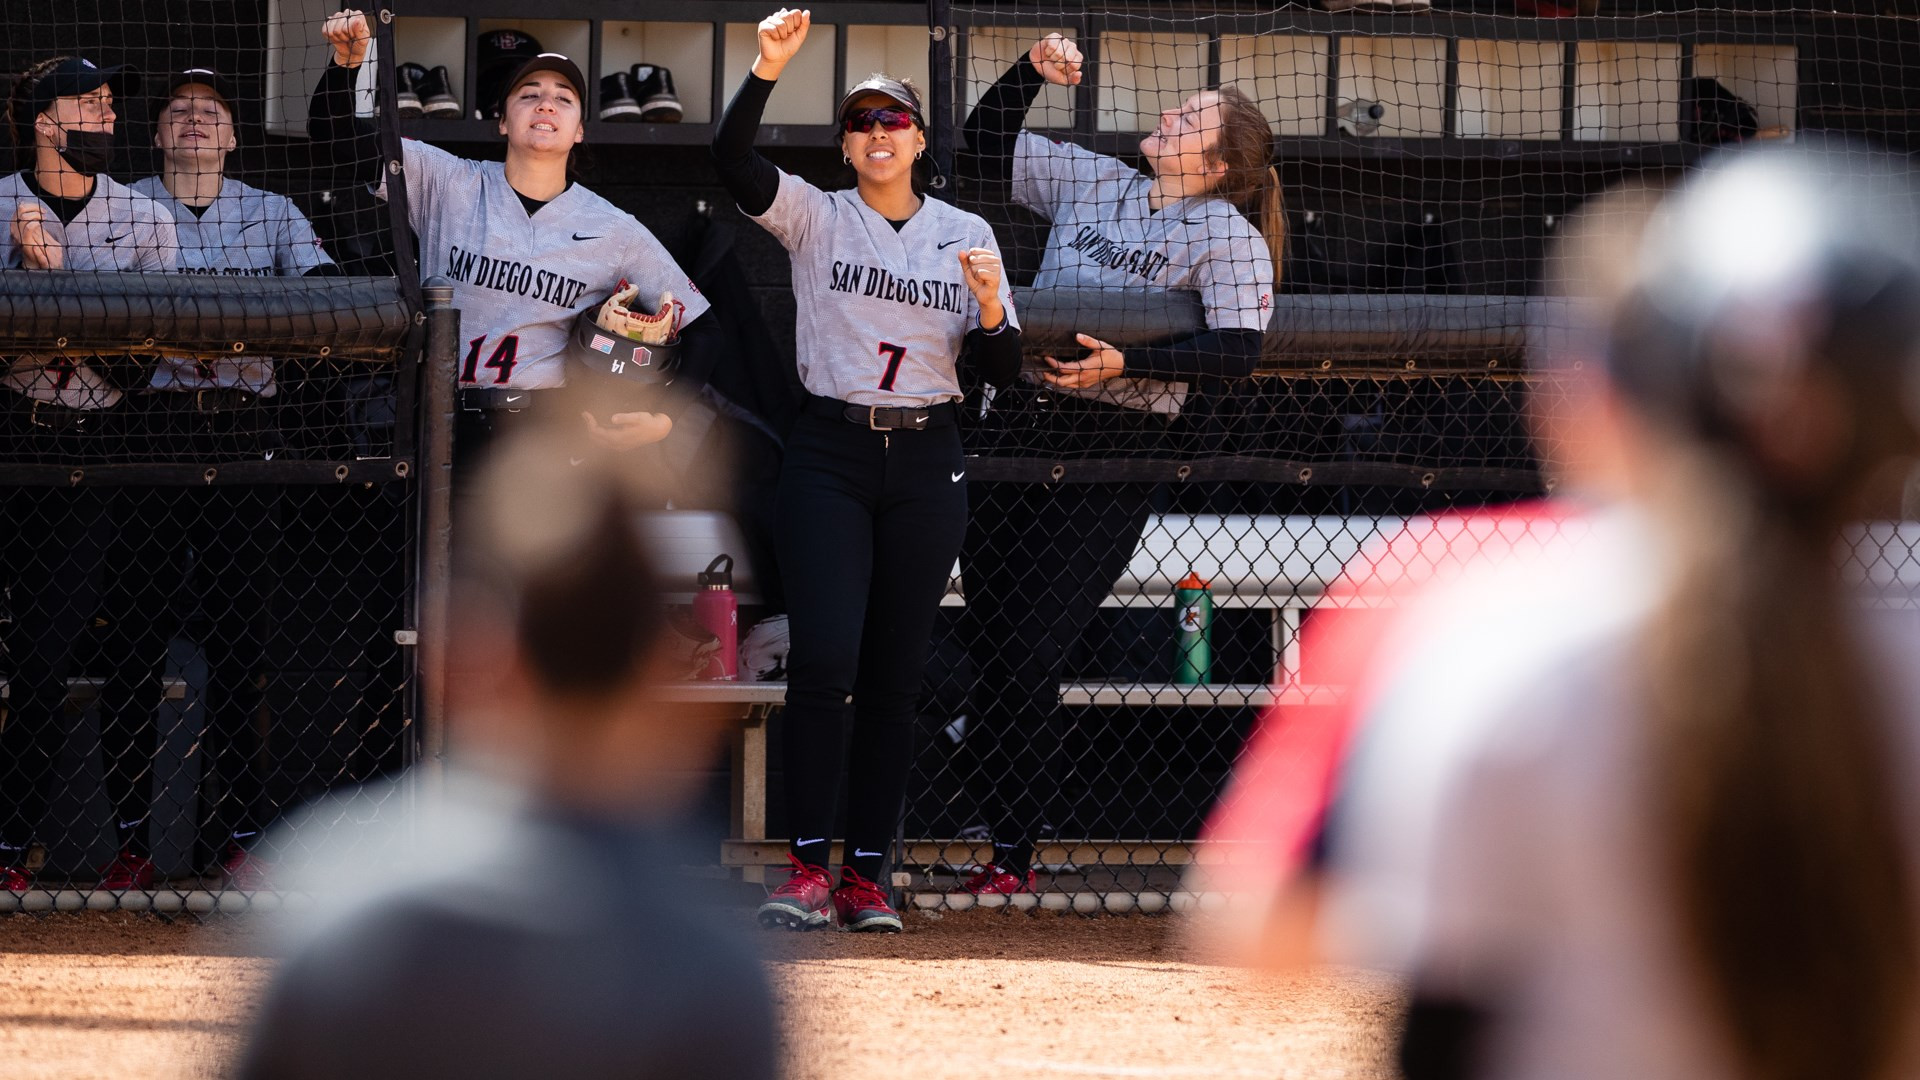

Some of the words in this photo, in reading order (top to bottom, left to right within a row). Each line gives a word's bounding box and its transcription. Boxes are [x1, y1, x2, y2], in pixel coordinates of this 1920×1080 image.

[446, 245, 478, 285] SAN
[473, 255, 533, 297] DIEGO
[531, 269, 588, 310] STATE
[829, 260, 865, 296] SAN
[863, 266, 919, 306] DIEGO
[458, 333, 520, 385] 14
[611, 358, 626, 375] 14
[877, 341, 908, 393] 7
